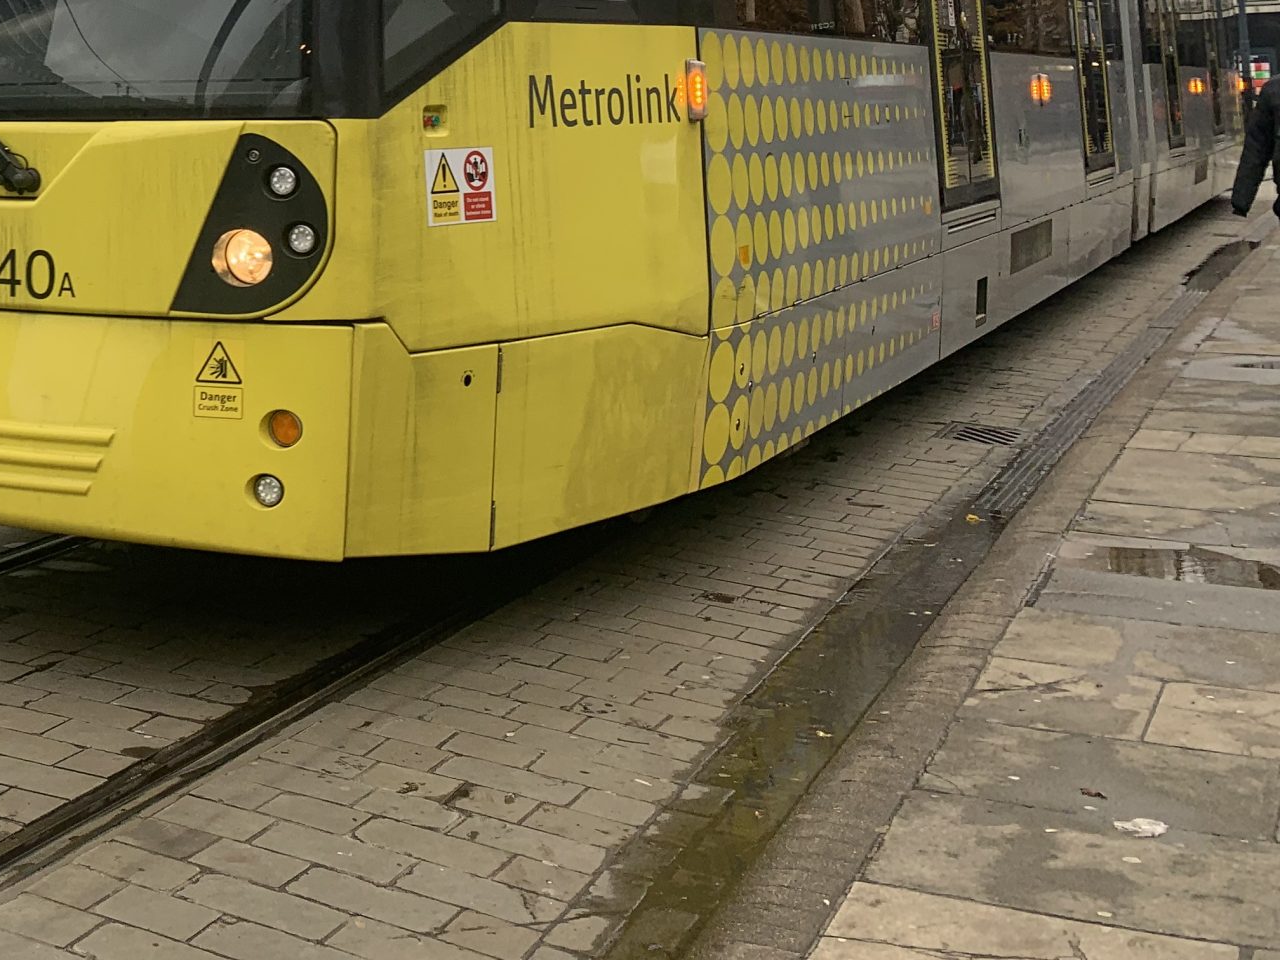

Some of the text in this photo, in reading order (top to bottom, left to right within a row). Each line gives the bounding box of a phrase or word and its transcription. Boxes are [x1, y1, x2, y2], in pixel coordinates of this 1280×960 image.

[528, 74, 681, 128] Metrolink
[433, 199, 459, 211] Danger
[200, 391, 237, 404] Danger
[198, 403, 238, 412] Crush Zone
